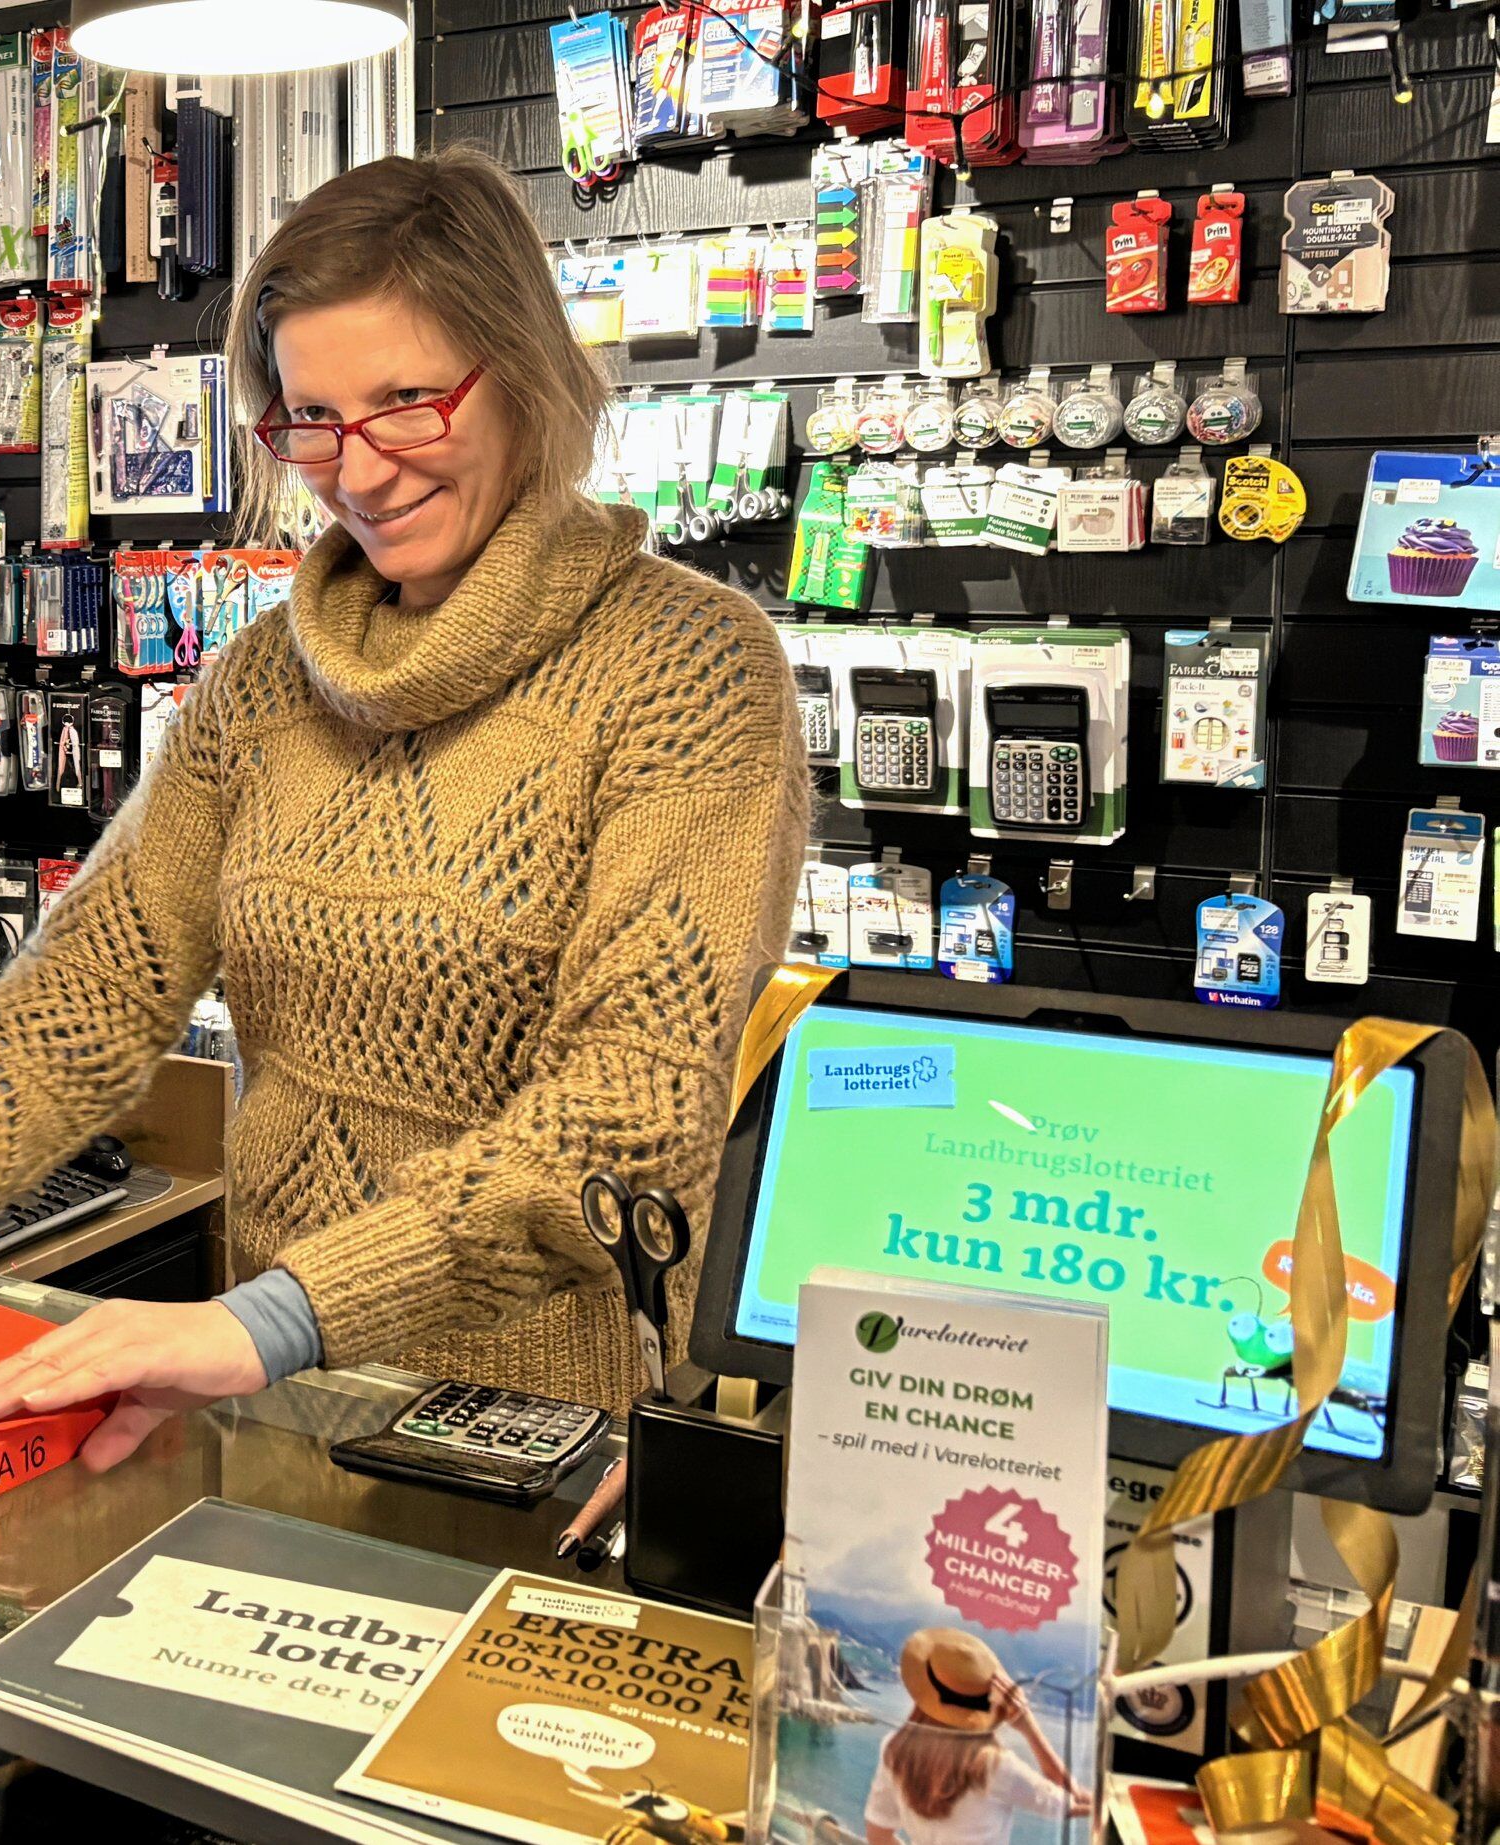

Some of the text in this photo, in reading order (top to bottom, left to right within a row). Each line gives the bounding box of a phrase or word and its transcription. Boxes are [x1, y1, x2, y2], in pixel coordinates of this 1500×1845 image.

[644, 14, 687, 40] LOCTITE
[932, 21, 944, 79] Kontaktlim
[1113, 237, 1135, 249] Pritt
[1205, 225, 1229, 238] Pritt
[1302, 224, 1361, 237] MOUNTING TAPE
[1300, 249, 1340, 260] INTERIOR
[1227, 476, 1268, 488] Scotch
[256, 566, 293, 577] Maped
[1174, 682, 1205, 691] Tack-It
[1410, 845, 1442, 855] INKJET
[853, 876, 868, 887] 64
[996, 902, 1008, 911] 16
[1431, 907, 1459, 917] BLACK
[1259, 924, 1279, 935] 128
[1220, 992, 1261, 1007] Verbatim
[824, 1063, 911, 1078] Landbrugs
[844, 1077, 911, 1091] lotteriet
[1029, 1113, 1100, 1146] Prøv
[924, 1131, 1215, 1194] Landbrugslotteriet
[962, 1182, 1159, 1242] 3 mdr.
[881, 1213, 1236, 1313] kun 180 kr.
[857, 1310, 1030, 1354] Varelotteriet
[848, 1366, 1034, 1412] GIV DIN DRØM
[863, 1400, 1015, 1441] EN CHANCE
[19, 1434, 47, 1472] 16
[831, 1430, 868, 1453] spil
[870, 1436, 918, 1460] med
[933, 1443, 1062, 1482] Varelotteriet
[983, 1502, 1030, 1549] 4
[933, 1528, 1070, 1583] MILLIONÆR-
[943, 1555, 1053, 1603] CHANCER
[526, 1592, 602, 1613] Landbrugs
[473, 1628, 714, 1696] 10x100.000
[508, 1611, 746, 1684] EKSTRA
[153, 1646, 279, 1687] Numre
[286, 1670, 353, 1702] der
[460, 1646, 703, 1715] 100x10.000
[607, 1702, 639, 1719] Spil
[640, 1711, 678, 1728] med
[506, 1712, 644, 1751] Gå ikke glip af
